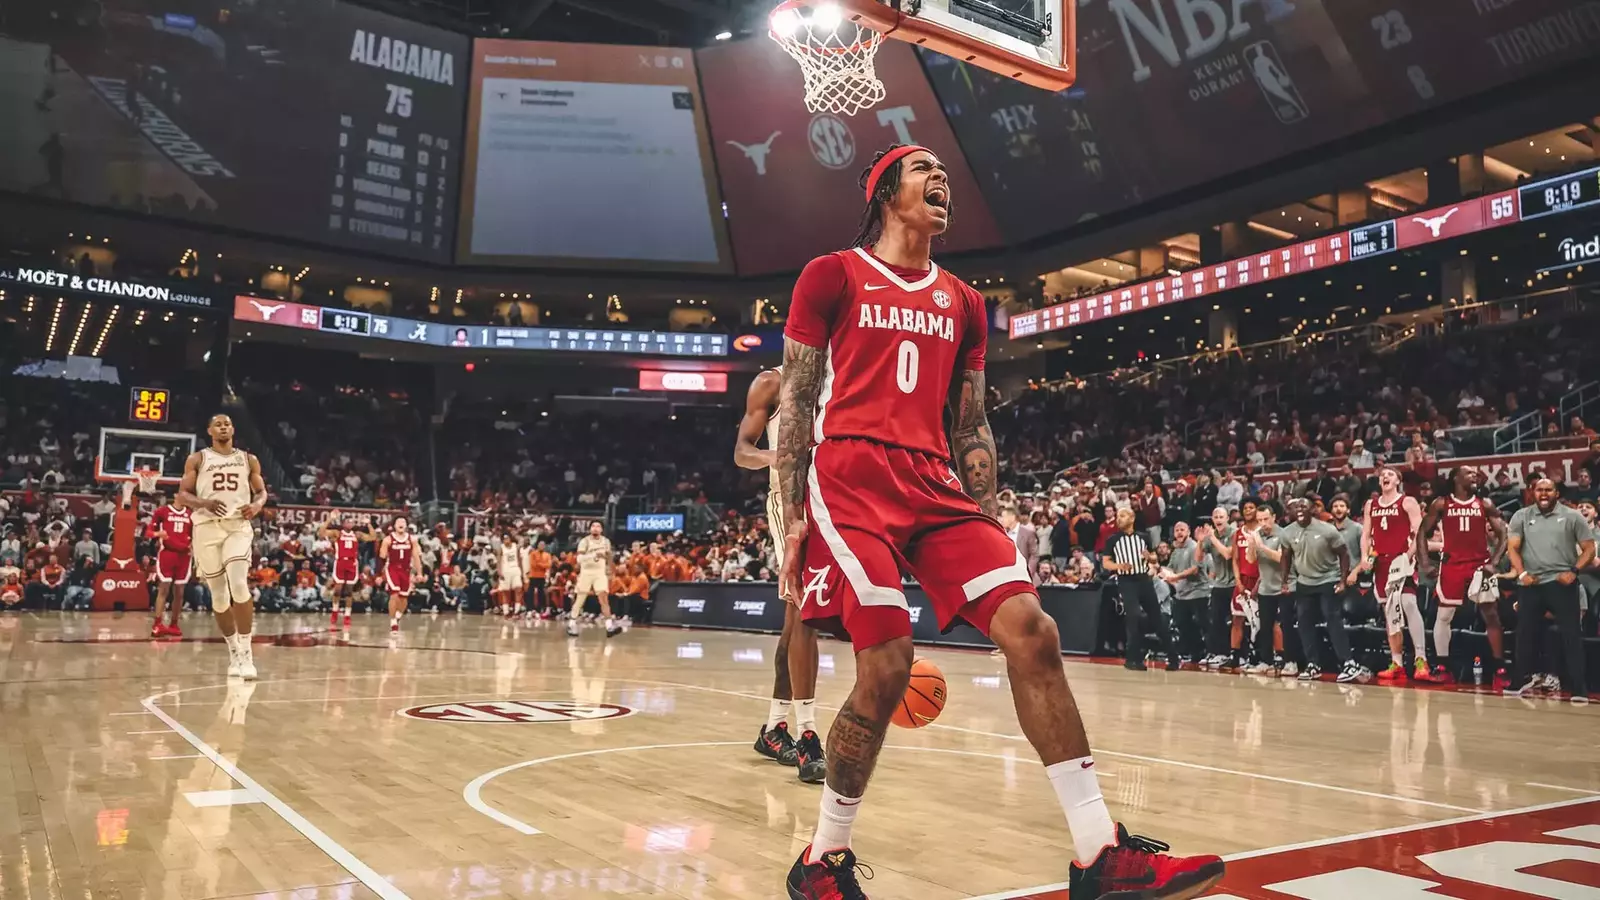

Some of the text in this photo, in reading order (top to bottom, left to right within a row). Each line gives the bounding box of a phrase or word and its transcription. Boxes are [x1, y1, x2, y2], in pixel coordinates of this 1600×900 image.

[1371, 9, 1412, 49] 23
[349, 29, 455, 86] ALABAMA
[1192, 52, 1238, 81] KEVIN
[1188, 69, 1246, 101] DURANT
[385, 83, 413, 118] 75
[808, 114, 850, 166] SEC
[1545, 181, 1581, 206] 8:19
[1491, 196, 1513, 220] 55
[1330, 237, 1342, 249] STL
[1353, 225, 1388, 243] TOL: 3
[1353, 241, 1377, 257] FOULS:
[1558, 235, 1600, 261] ind
[16, 267, 68, 287] MOËT
[70, 275, 84, 290] &
[86, 278, 170, 301] CHANDON
[170, 293, 212, 306] LOUNGE
[302, 308, 319, 325] 55
[334, 314, 358, 330] 8:19
[373, 318, 389, 335] 75
[858, 303, 954, 342] ALABAMA
[1013, 313, 1037, 328] TEXAS
[481, 328, 489, 347] 1
[896, 340, 919, 394] 0
[136, 400, 161, 420] 26
[212, 472, 240, 491] 25
[634, 515, 675, 529] indeed
[1371, 508, 1399, 517] ALABAMA
[1380, 516, 1388, 531] 4
[1447, 508, 1482, 517] ALABAMA
[1459, 516, 1470, 532] 11
[116, 578, 140, 589] razr
